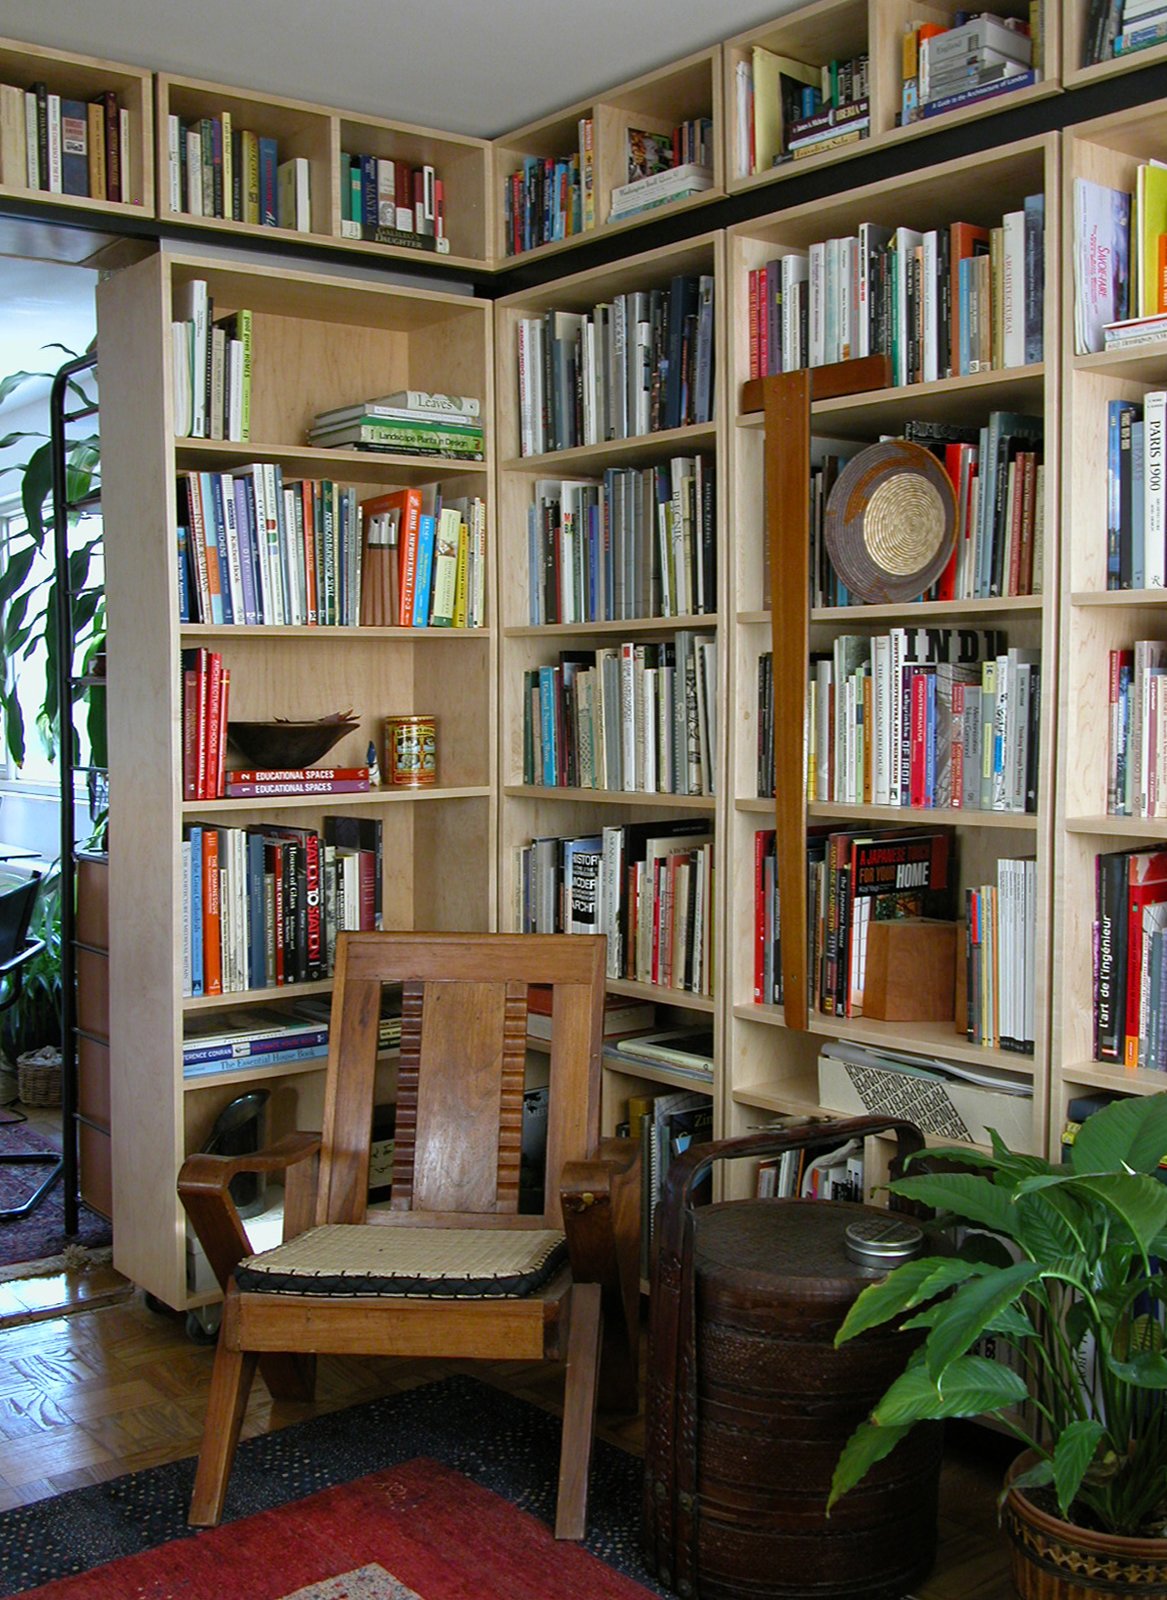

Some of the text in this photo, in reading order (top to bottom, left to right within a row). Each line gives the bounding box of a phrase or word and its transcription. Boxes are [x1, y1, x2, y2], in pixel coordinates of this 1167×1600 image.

[417, 394, 454, 410] Leaves
[379, 431, 416, 443] Landscape
[417, 433, 437, 444] Plants
[445, 437, 469, 448] Design
[1149, 420, 1161, 491] PARIS 1900
[409, 508, 418, 531] HOME
[217, 525, 227, 558] KITCHENS
[242, 548, 250, 564] DIY
[406, 533, 417, 587] IMPROVEMENT
[200, 561, 209, 593] VIEWS
[177, 581, 186, 613] Apartments
[210, 659, 220, 754] ARCHITECTURE SCHOOLS
[901, 688, 910, 785] Labyrinths OF IRON
[255, 771, 305, 781] EDUCATIONAL
[305, 769, 335, 780] SPACES
[1015, 726, 1025, 796] Thinking through Technology
[255, 783, 304, 793] EDUCATIONAL
[304, 782, 333, 791] SPACES
[289, 847, 297, 877] Houses
[896, 862, 930, 888] HOME
[211, 869, 219, 916] ROMANESQUE
[289, 887, 297, 909] Glass
[305, 836, 320, 959] STATION TO STATION
[838, 891, 846, 923] japanese
[828, 887, 836, 933] CABINETRY
[838, 925, 846, 948] house
[1099, 914, 1112, 1029] l'art de l'ingénieur
[184, 1052, 207, 1062] ERENCE
[220, 1061, 236, 1070] The
[237, 1055, 271, 1068] Essential
